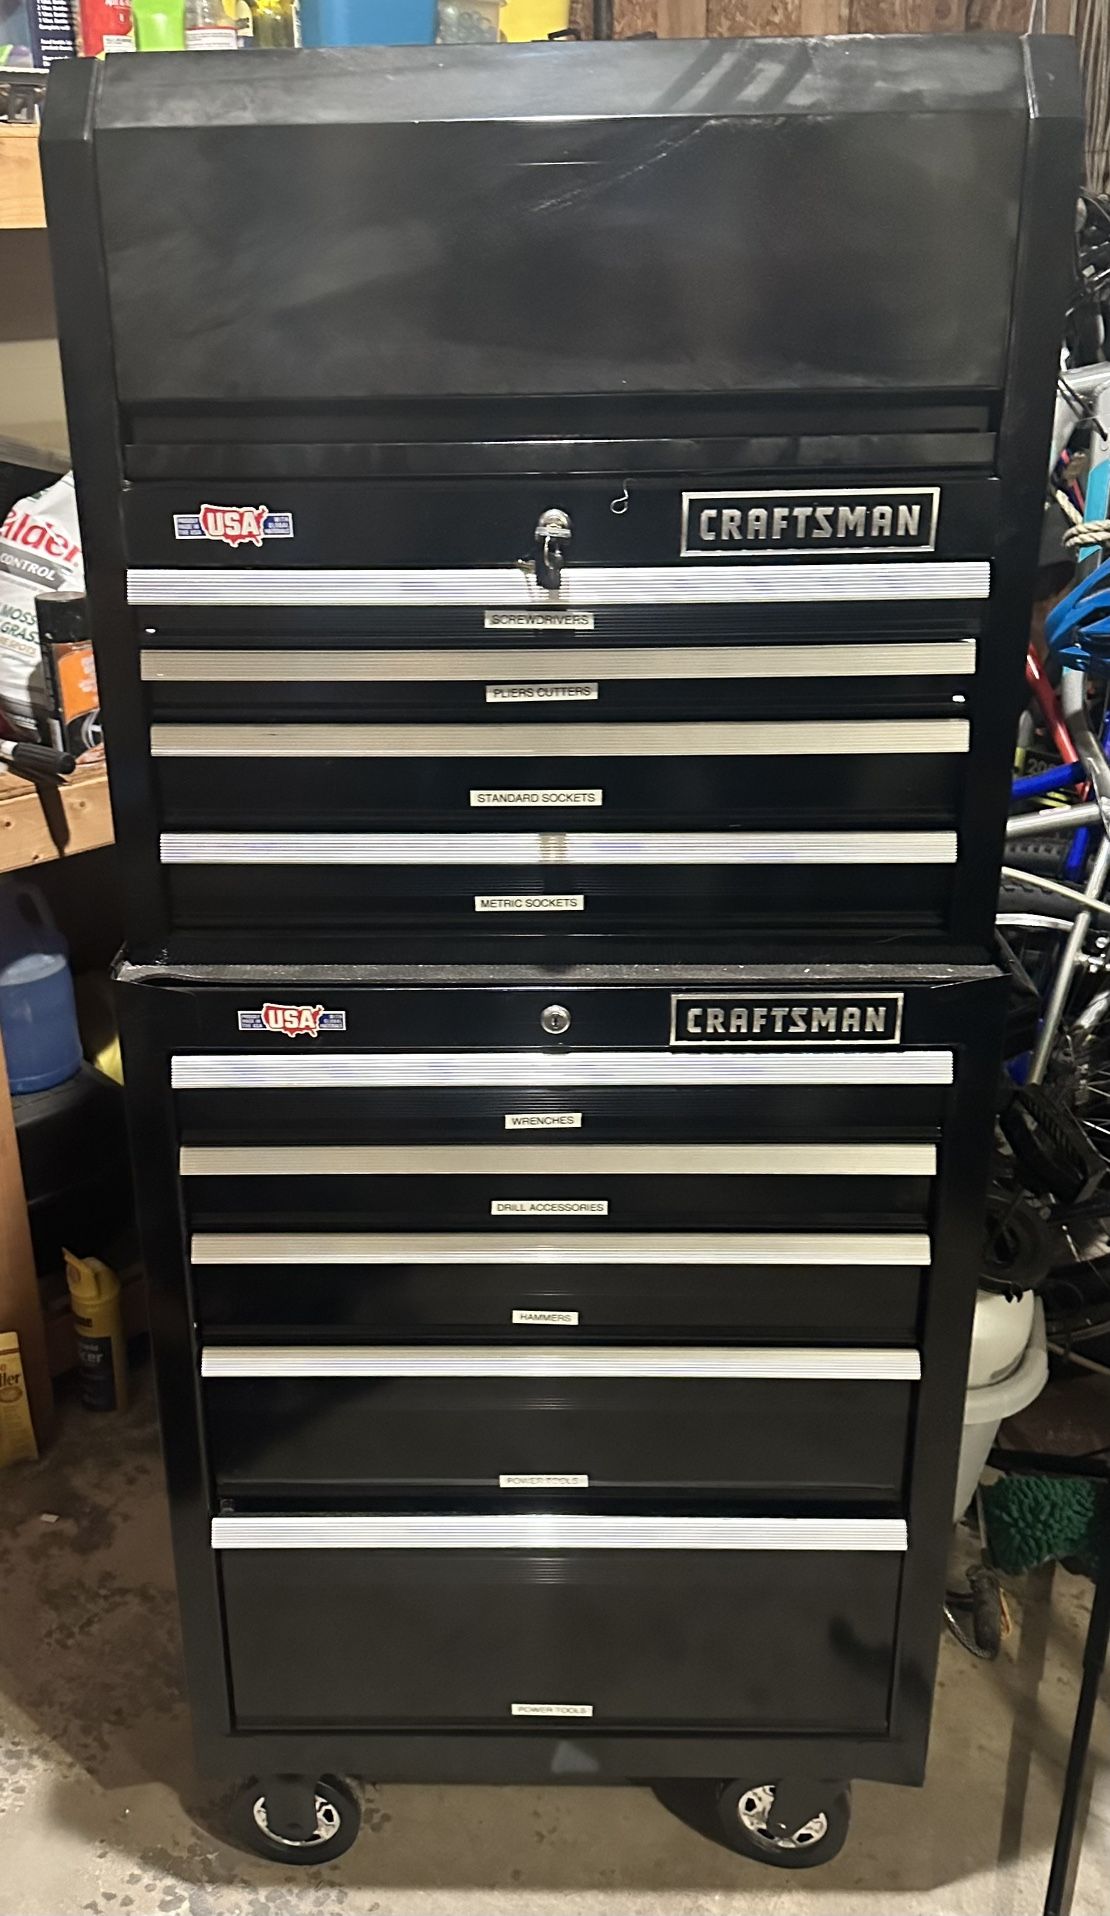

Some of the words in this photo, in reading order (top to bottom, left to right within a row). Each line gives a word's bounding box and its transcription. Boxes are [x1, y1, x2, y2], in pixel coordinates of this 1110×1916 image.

[206, 510, 260, 536] USA
[700, 504, 921, 541] CRAFTSMAN
[491, 614, 589, 625] SCREWDRIVERS
[0, 621, 41, 646] GRAS
[493, 687, 534, 698] PLIERS
[536, 686, 591, 697] CUTTERS
[477, 793, 539, 803] STANDARD
[541, 792, 596, 803] SOCKETS
[480, 899, 523, 909] METRIC
[525, 898, 578, 908] SOCKETS
[268, 1009, 317, 1029] USA
[687, 1006, 887, 1034] CRAFTSMAN
[511, 1115, 575, 1126] WRENCHES
[497, 1203, 526, 1212] DRILL
[529, 1203, 604, 1212] ACCESSORIES
[520, 1313, 572, 1323] HAMMERS
[518, 1706, 553, 1714] POWER
[555, 1706, 587, 1714] TOOLS
